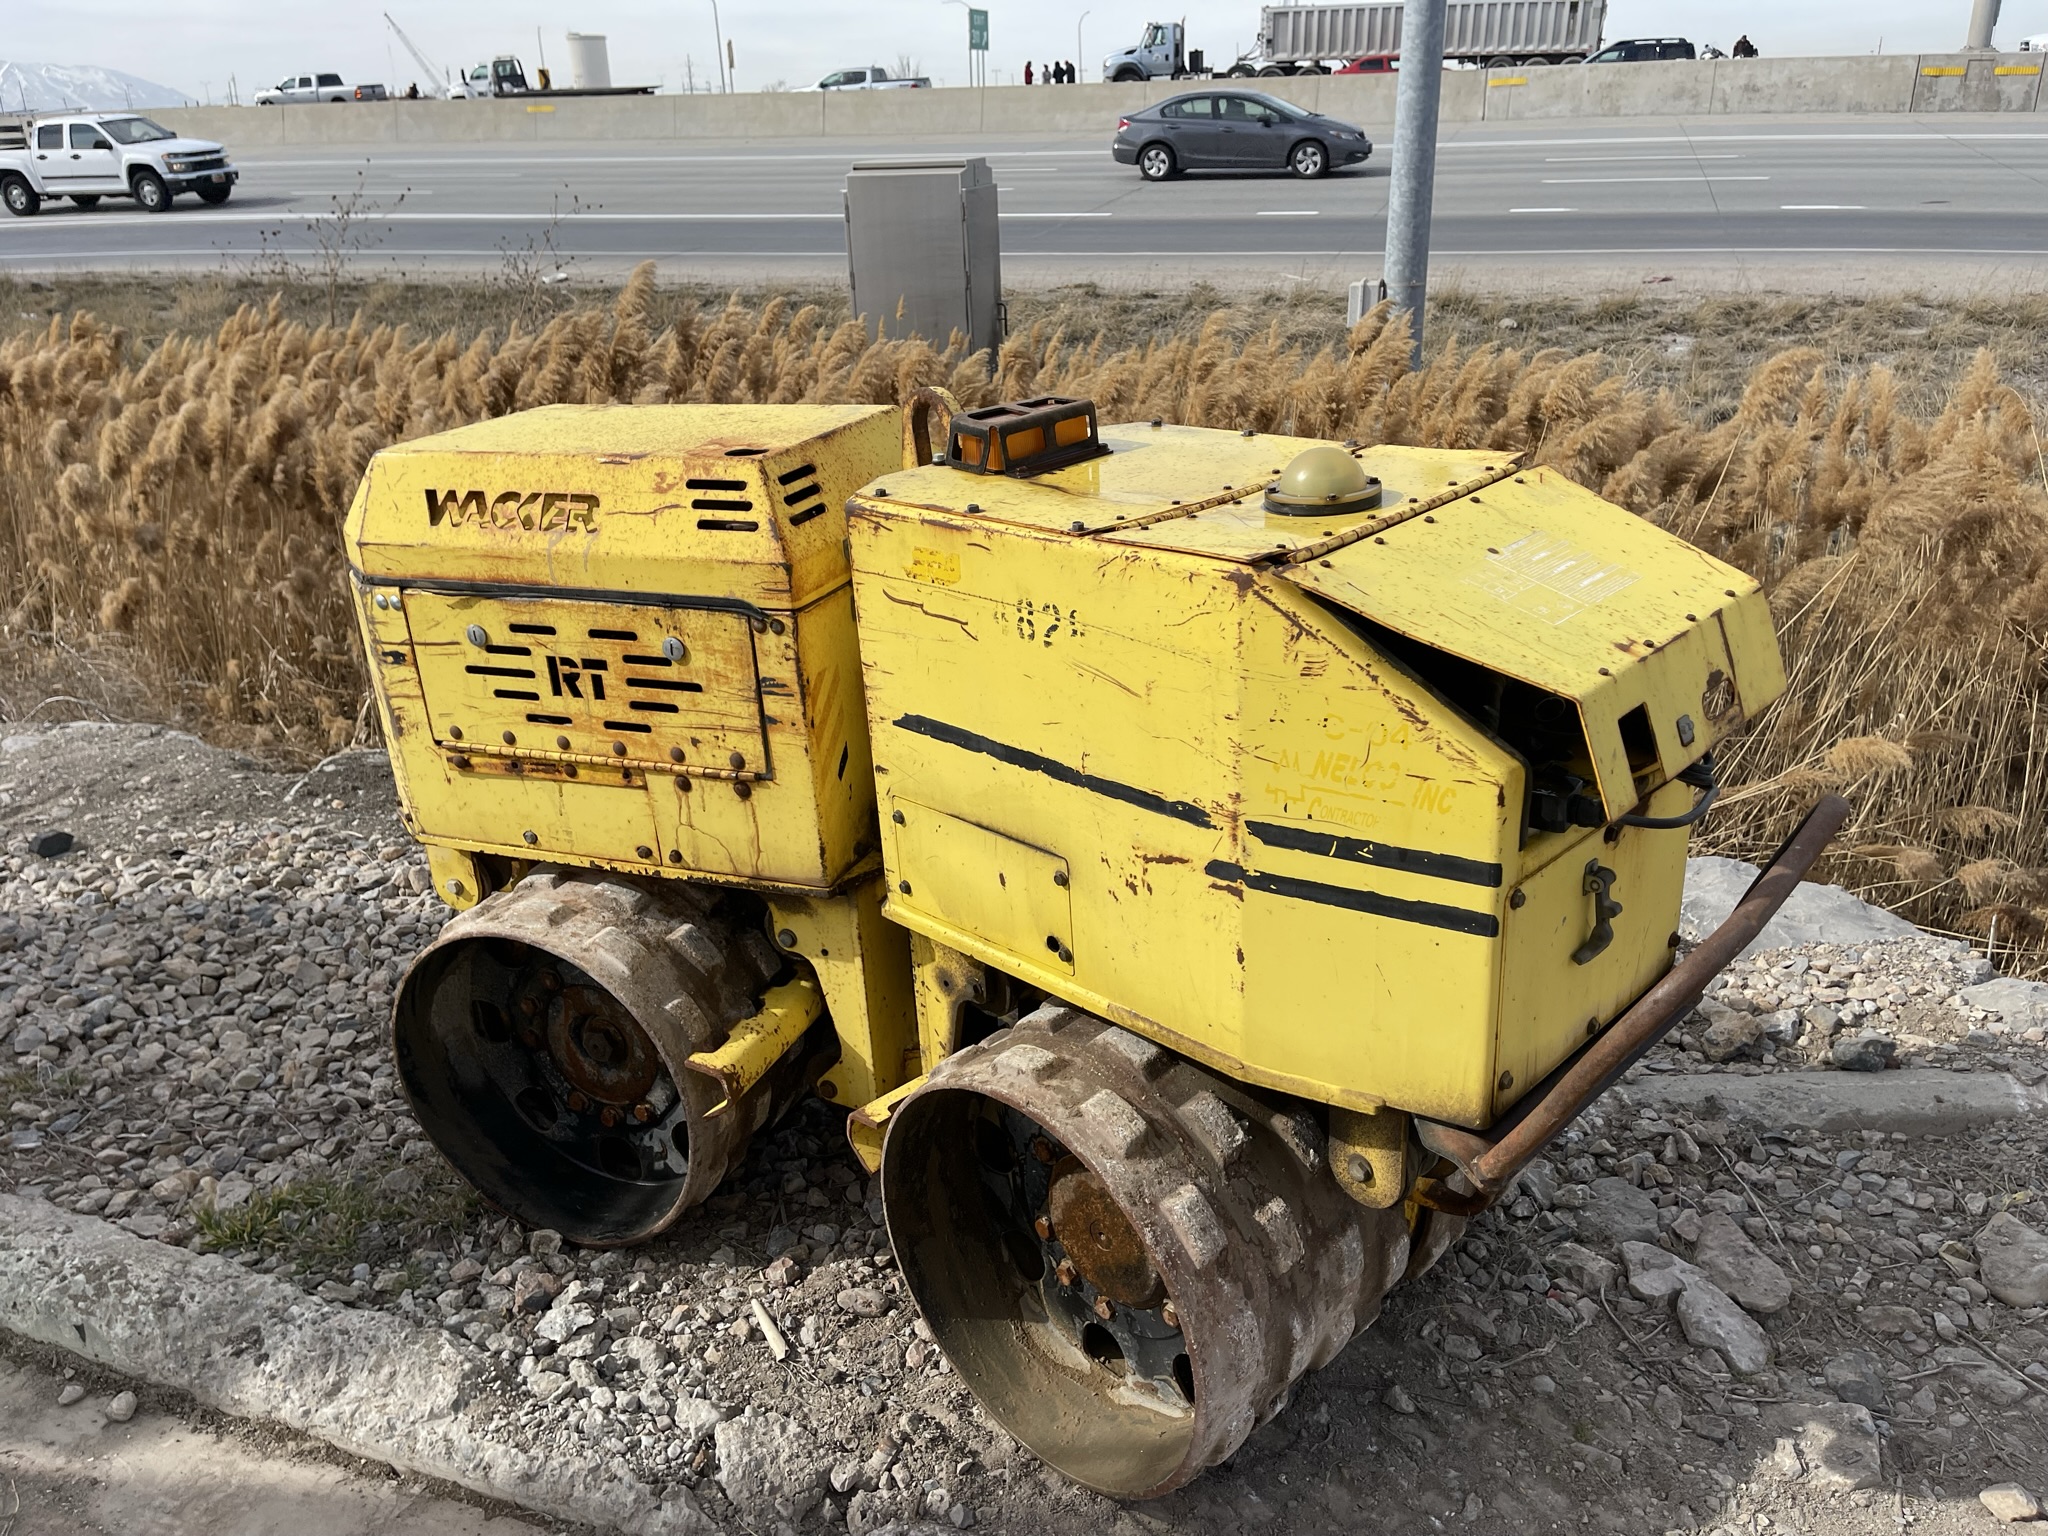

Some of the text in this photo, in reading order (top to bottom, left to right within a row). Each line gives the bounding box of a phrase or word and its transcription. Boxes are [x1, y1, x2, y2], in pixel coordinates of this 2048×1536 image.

[425, 489, 600, 533] WACKER
[545, 655, 608, 700] RT
[1412, 780, 1457, 814] INC
